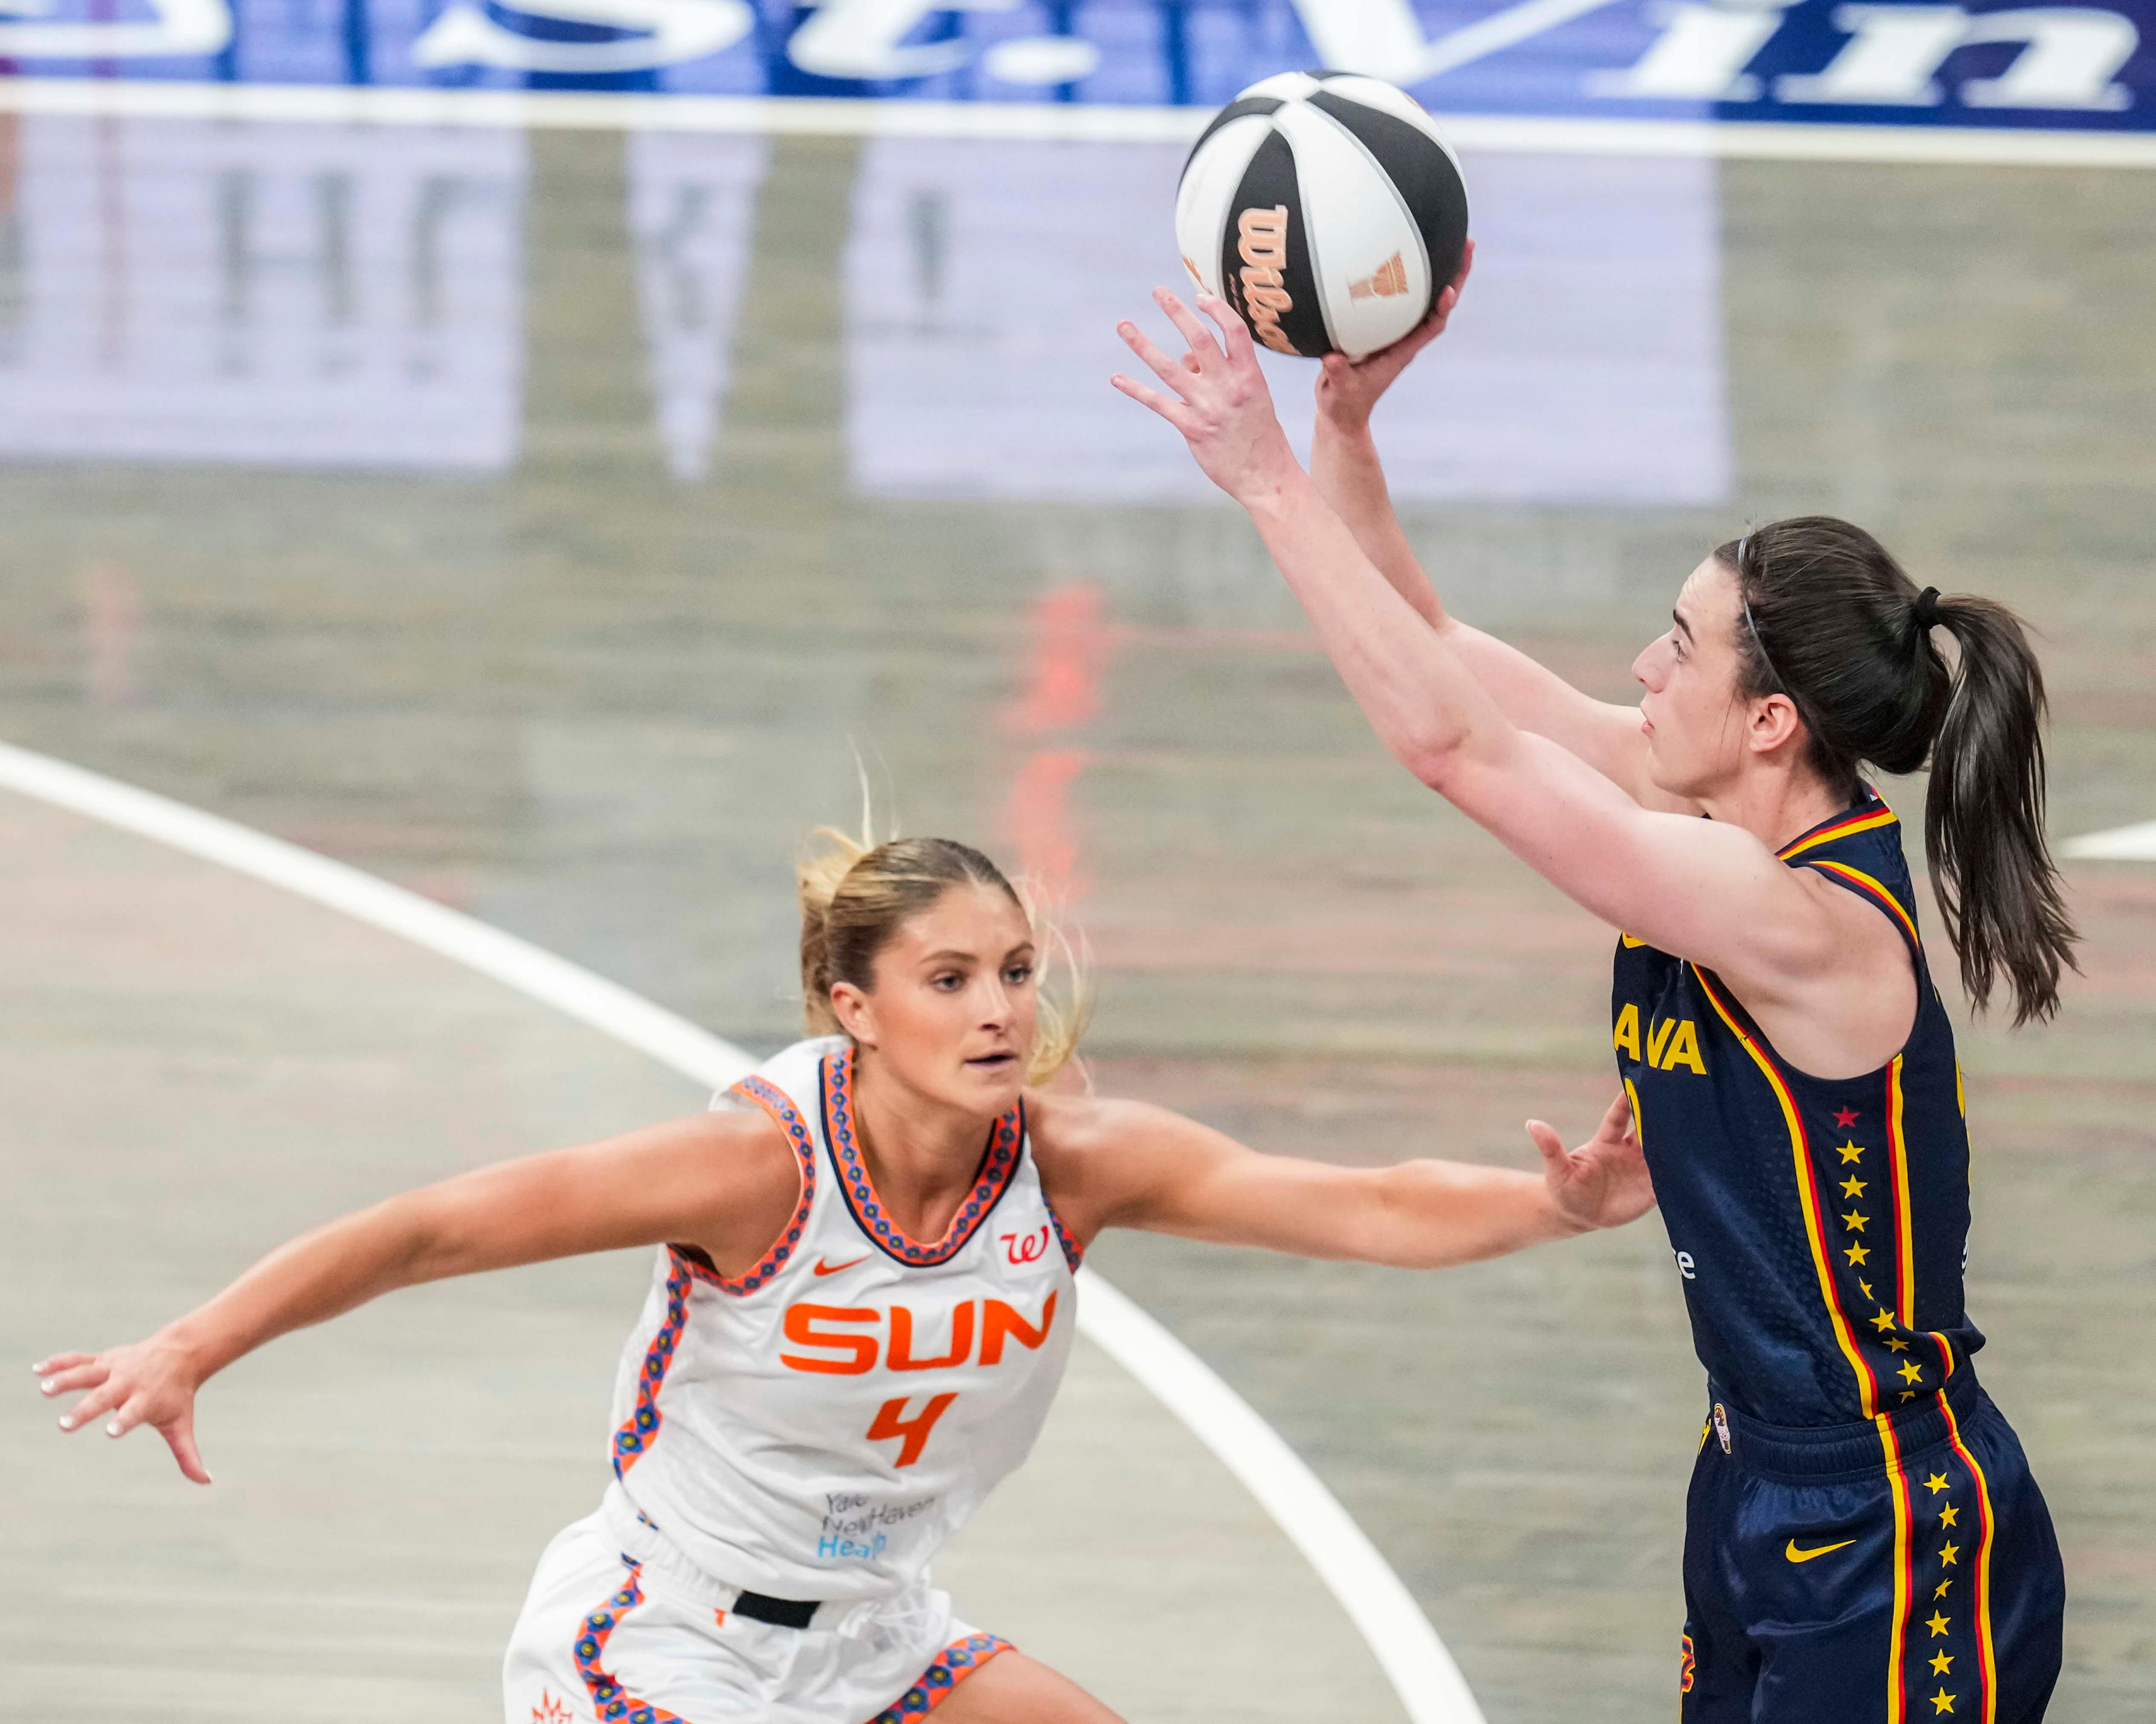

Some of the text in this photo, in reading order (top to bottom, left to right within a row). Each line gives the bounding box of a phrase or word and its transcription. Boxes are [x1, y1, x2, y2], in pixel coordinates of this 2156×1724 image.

[780, 1289, 1058, 1375] SUN
[866, 1392, 961, 1469] 4
[826, 1493, 867, 1514] Yae
